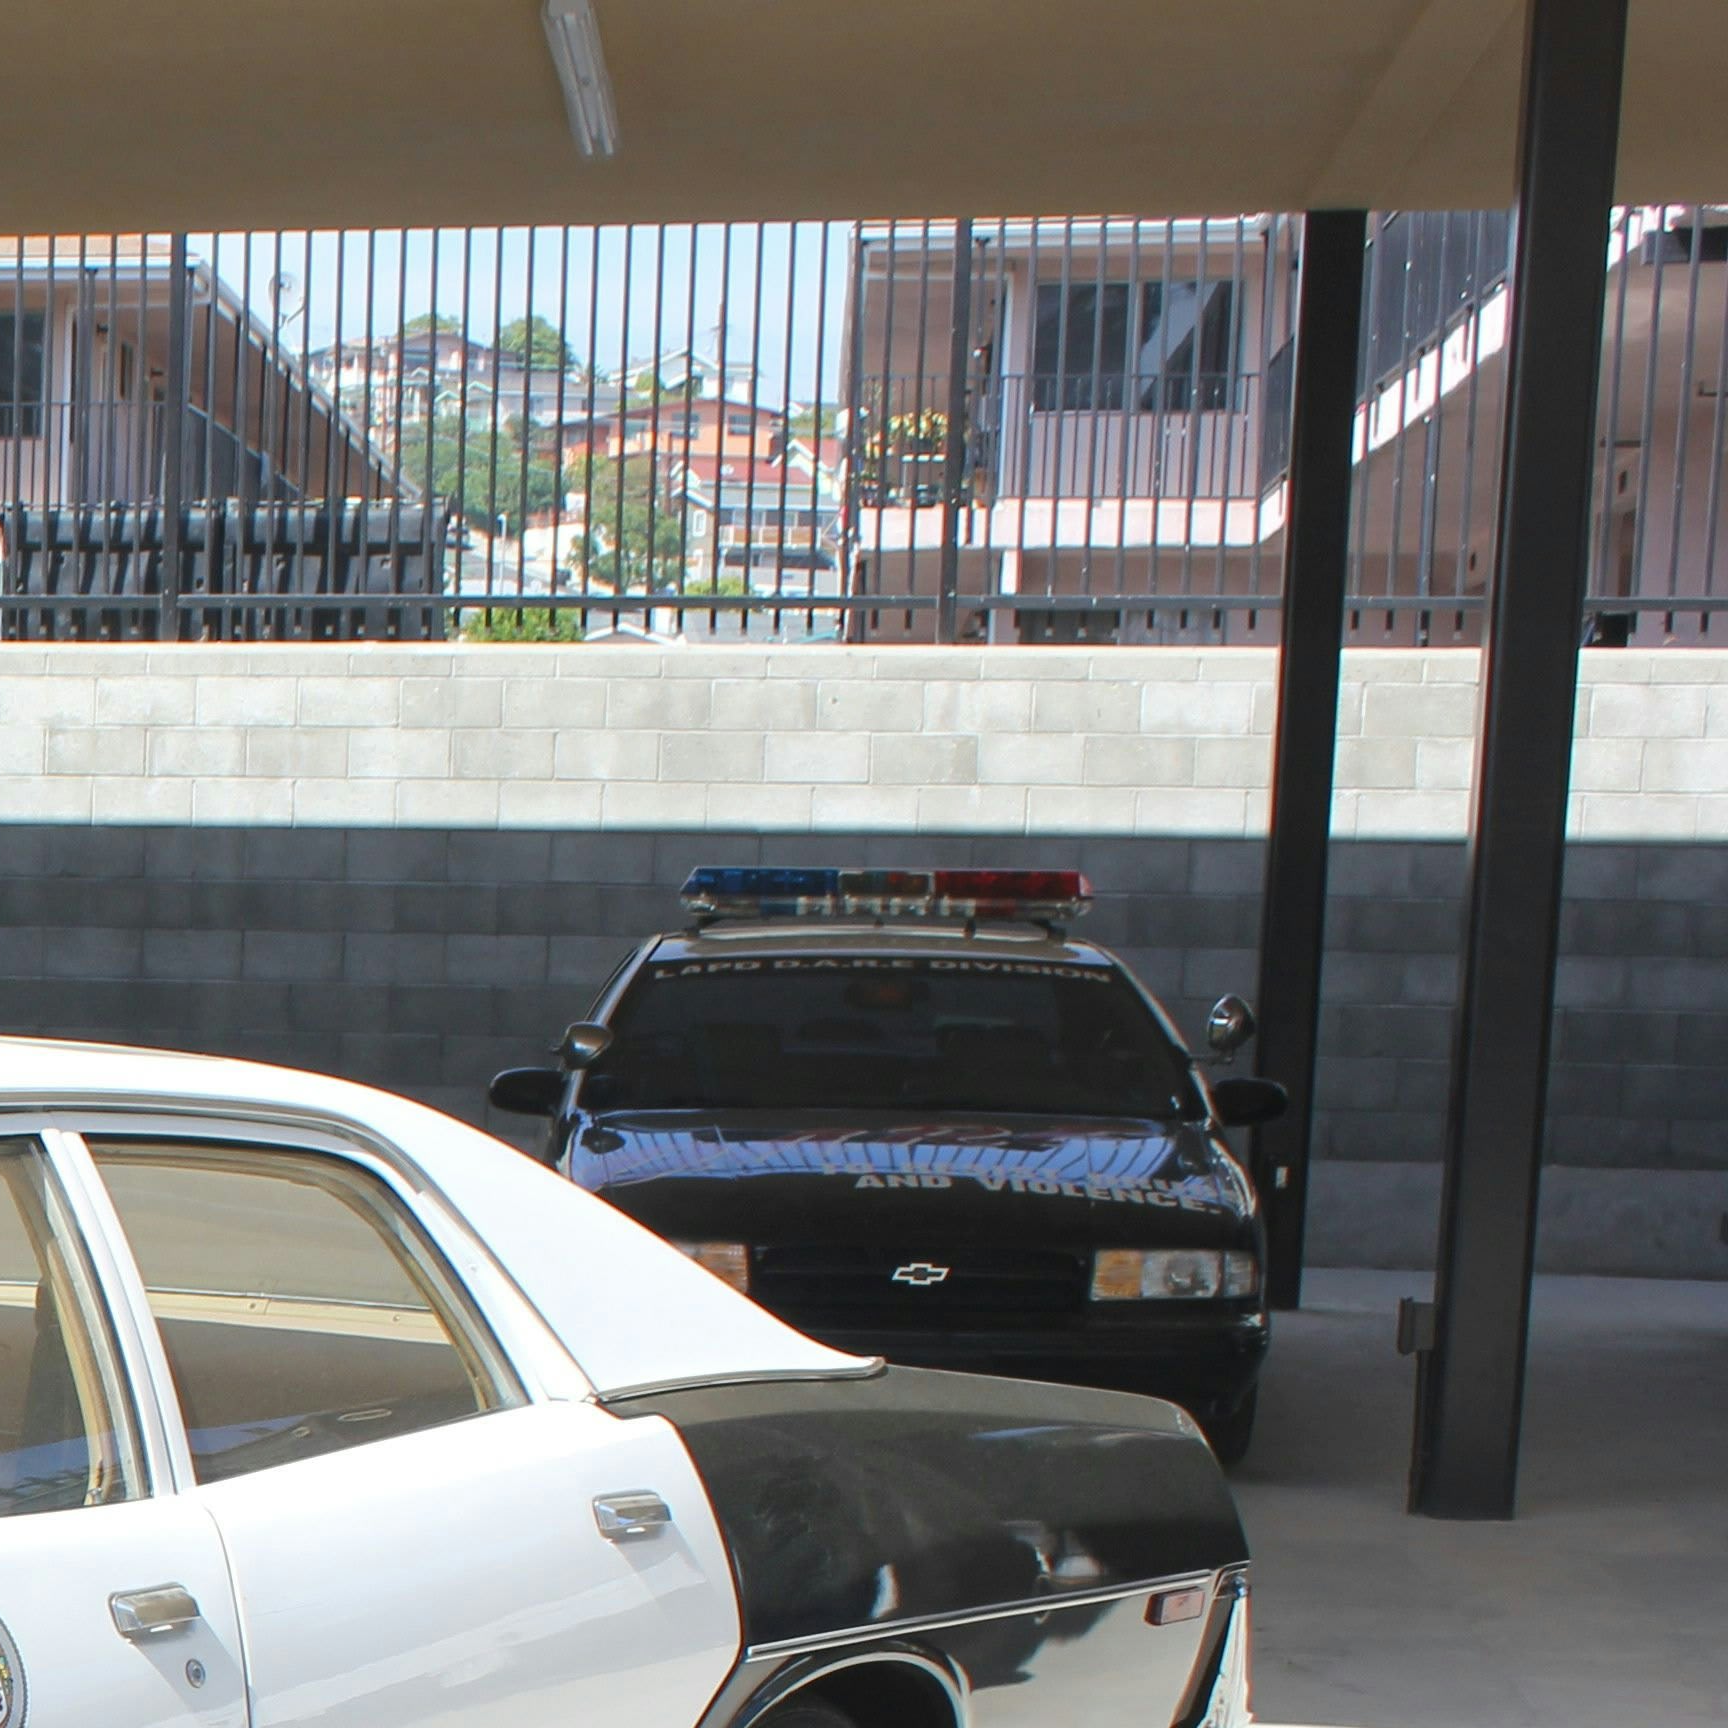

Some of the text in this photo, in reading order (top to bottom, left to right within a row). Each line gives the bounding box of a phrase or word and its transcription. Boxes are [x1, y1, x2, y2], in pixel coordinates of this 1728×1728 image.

[655, 960, 761, 980] LAPD
[929, 960, 1112, 983] DIVISION
[854, 1175, 953, 1189] AND
